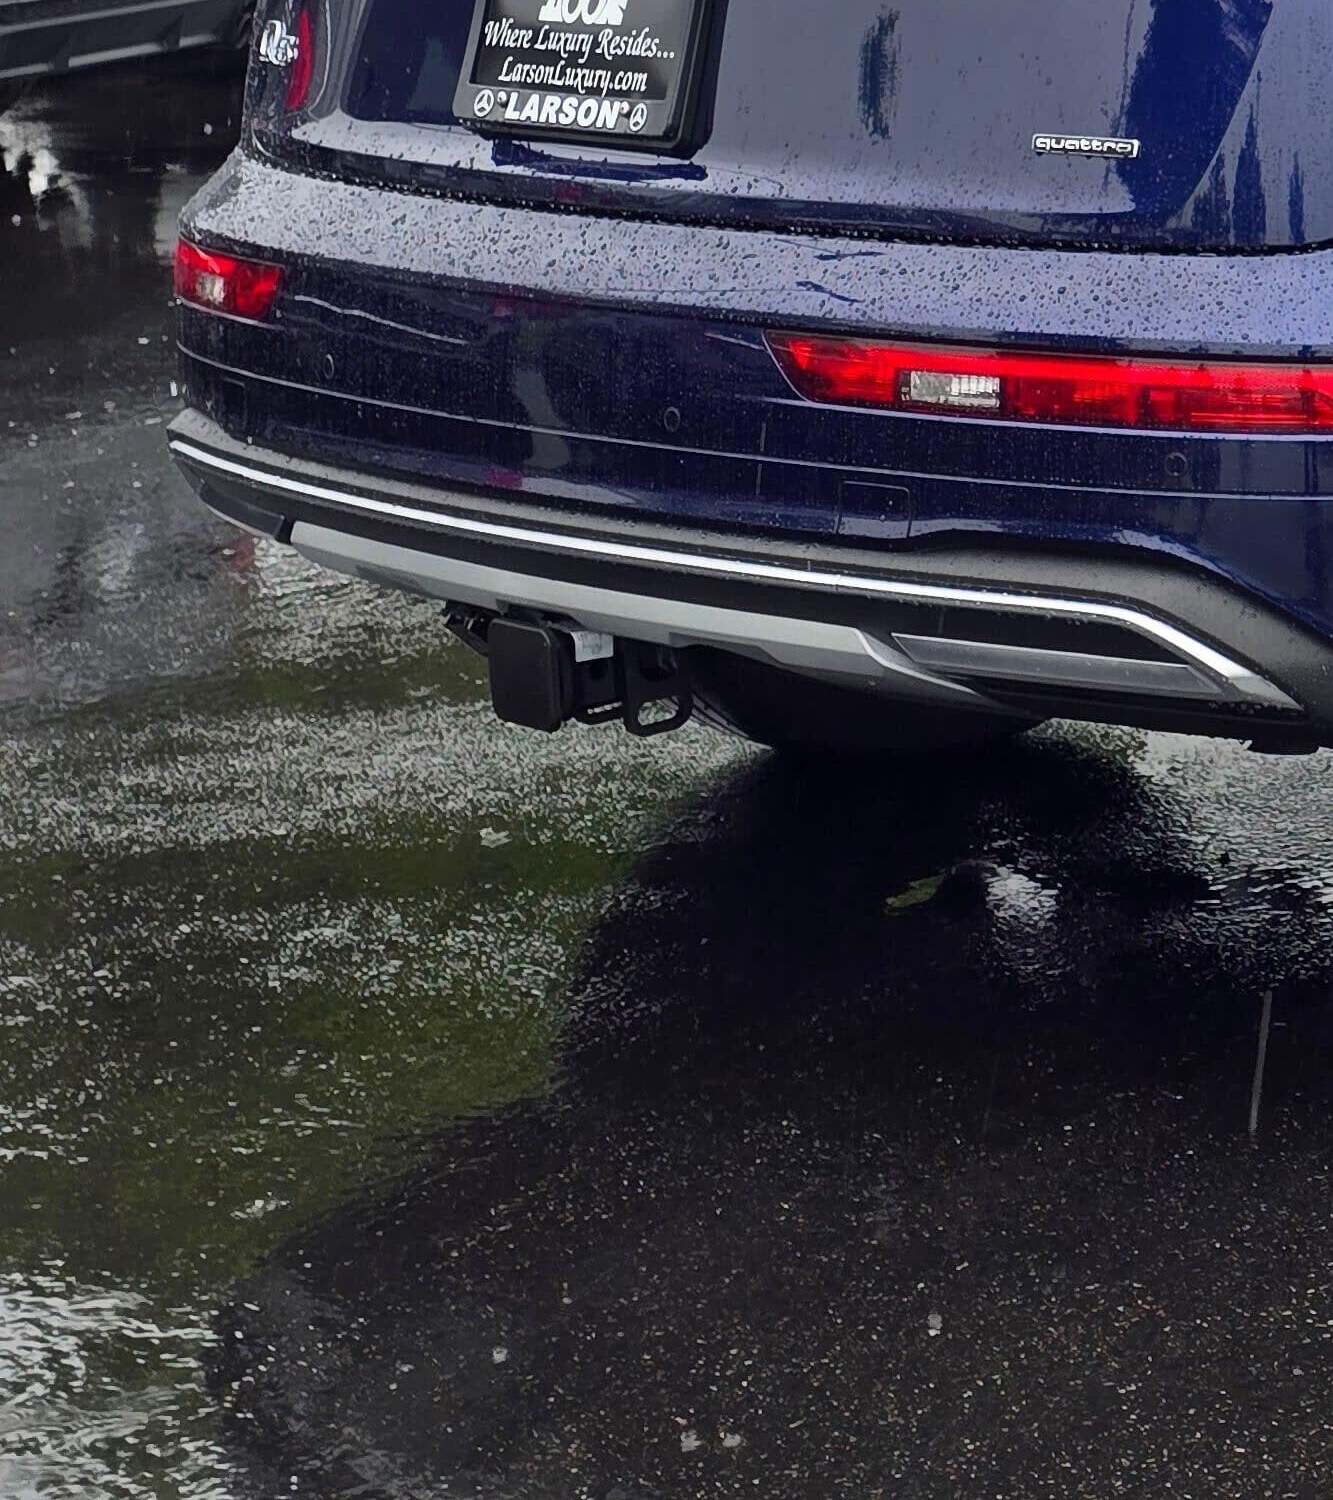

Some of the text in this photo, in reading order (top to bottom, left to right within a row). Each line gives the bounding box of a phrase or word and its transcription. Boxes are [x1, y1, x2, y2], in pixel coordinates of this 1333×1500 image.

[484, 17, 533, 50] Where
[534, 24, 595, 64] Luxury
[497, 55, 649, 99] LarsonLuxury.com
[504, 91, 621, 130] LARSON
[1035, 136, 1132, 154] quattro
